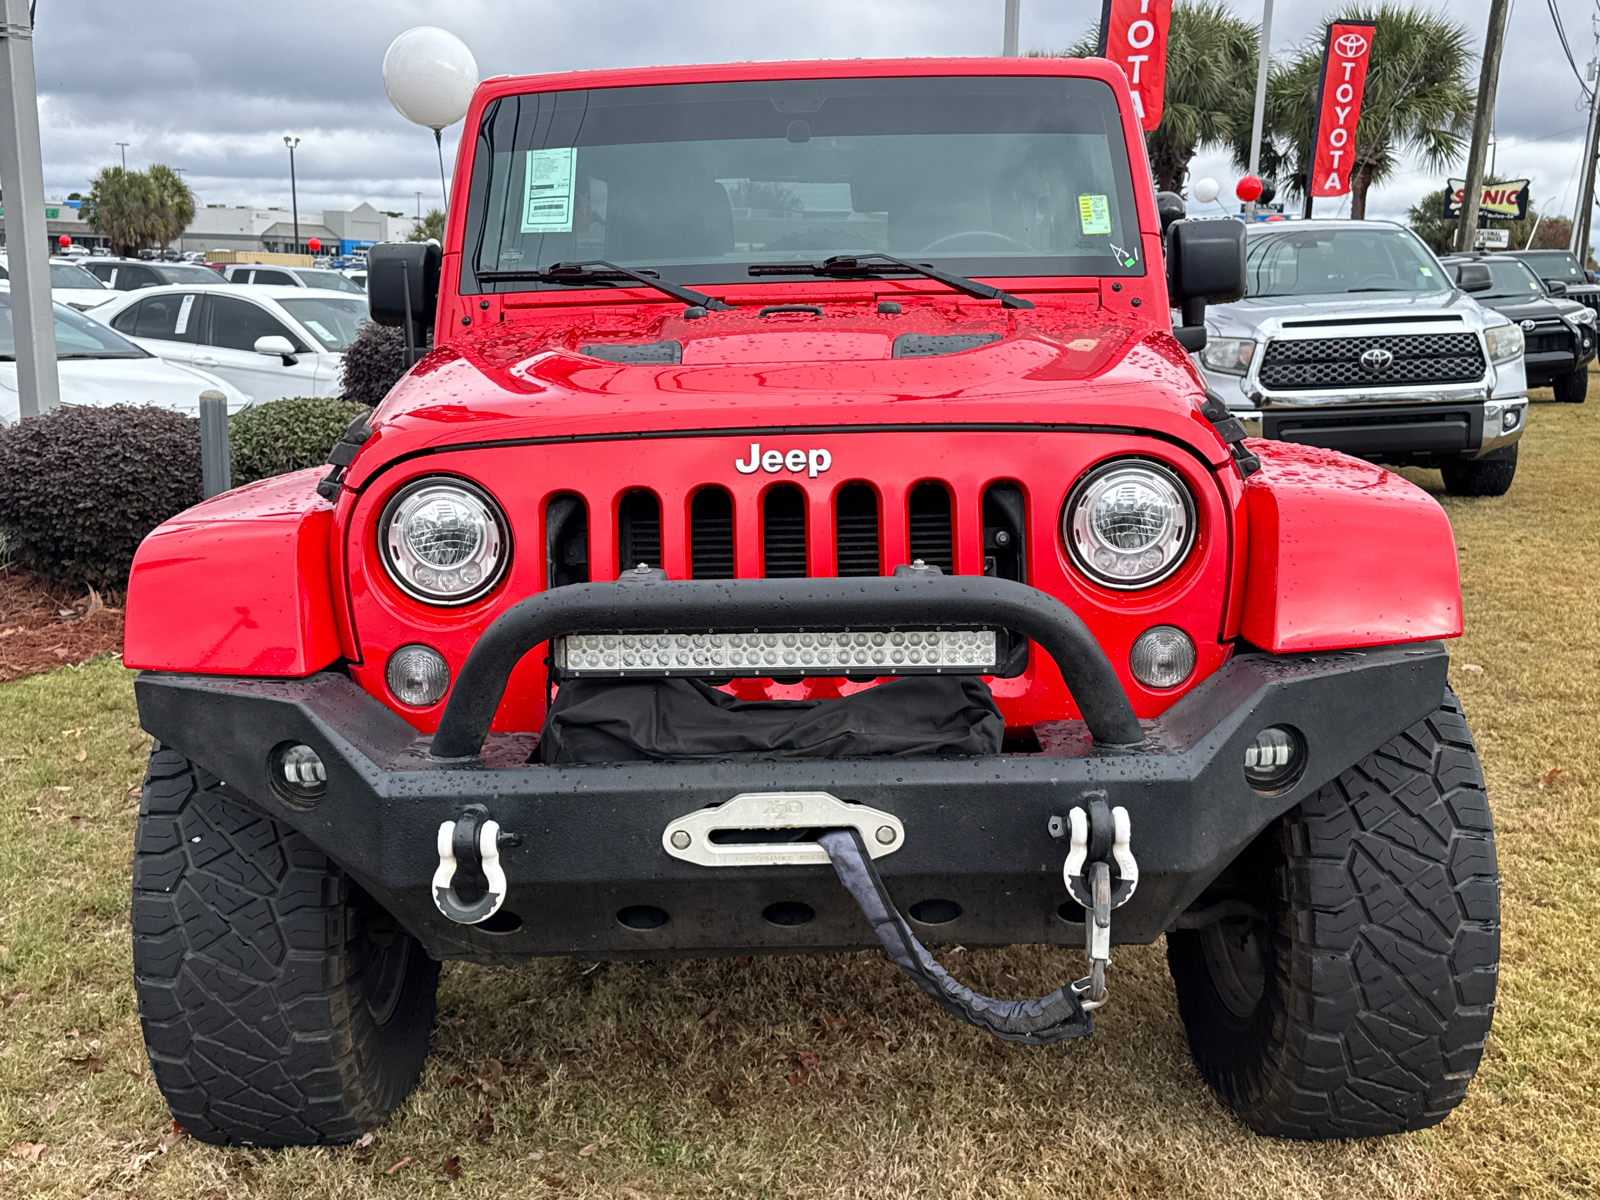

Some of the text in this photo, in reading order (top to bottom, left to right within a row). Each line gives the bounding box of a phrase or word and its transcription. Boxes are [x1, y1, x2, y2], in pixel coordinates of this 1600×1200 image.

[1323, 62, 1356, 190] TOYOTA
[1452, 188, 1521, 206] SNIC
[735, 443, 832, 478] Jeep
